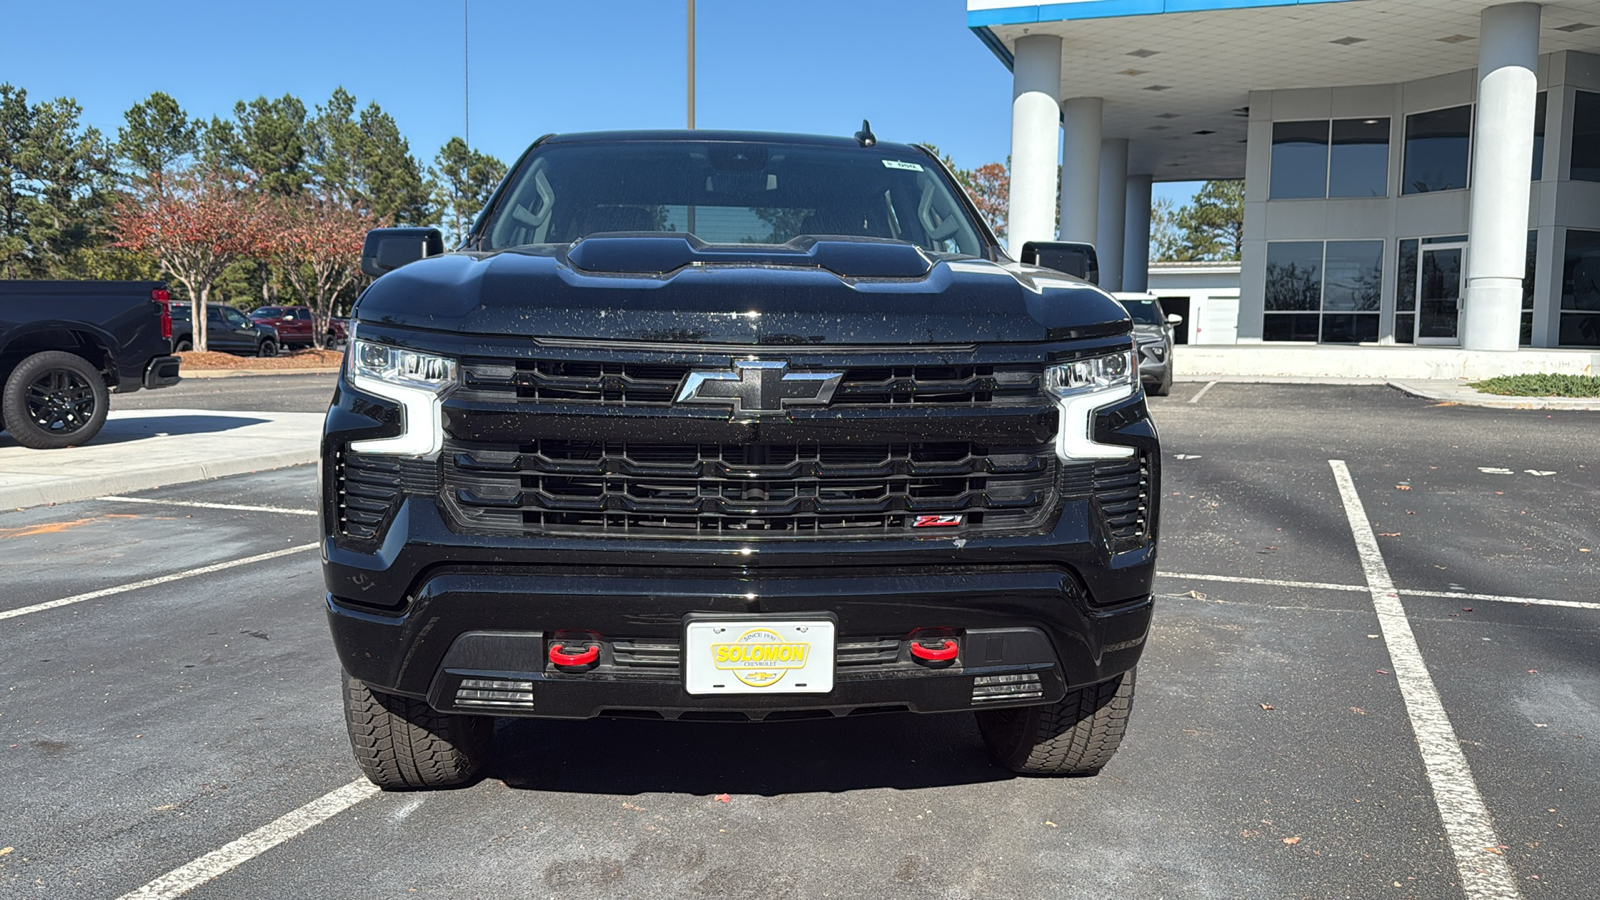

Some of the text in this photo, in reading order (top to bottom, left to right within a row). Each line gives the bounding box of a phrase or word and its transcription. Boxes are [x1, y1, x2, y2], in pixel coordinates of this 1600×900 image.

[912, 515, 962, 526] Z71
[744, 633, 762, 642] SINCE
[717, 645, 804, 662] SOLOMON
